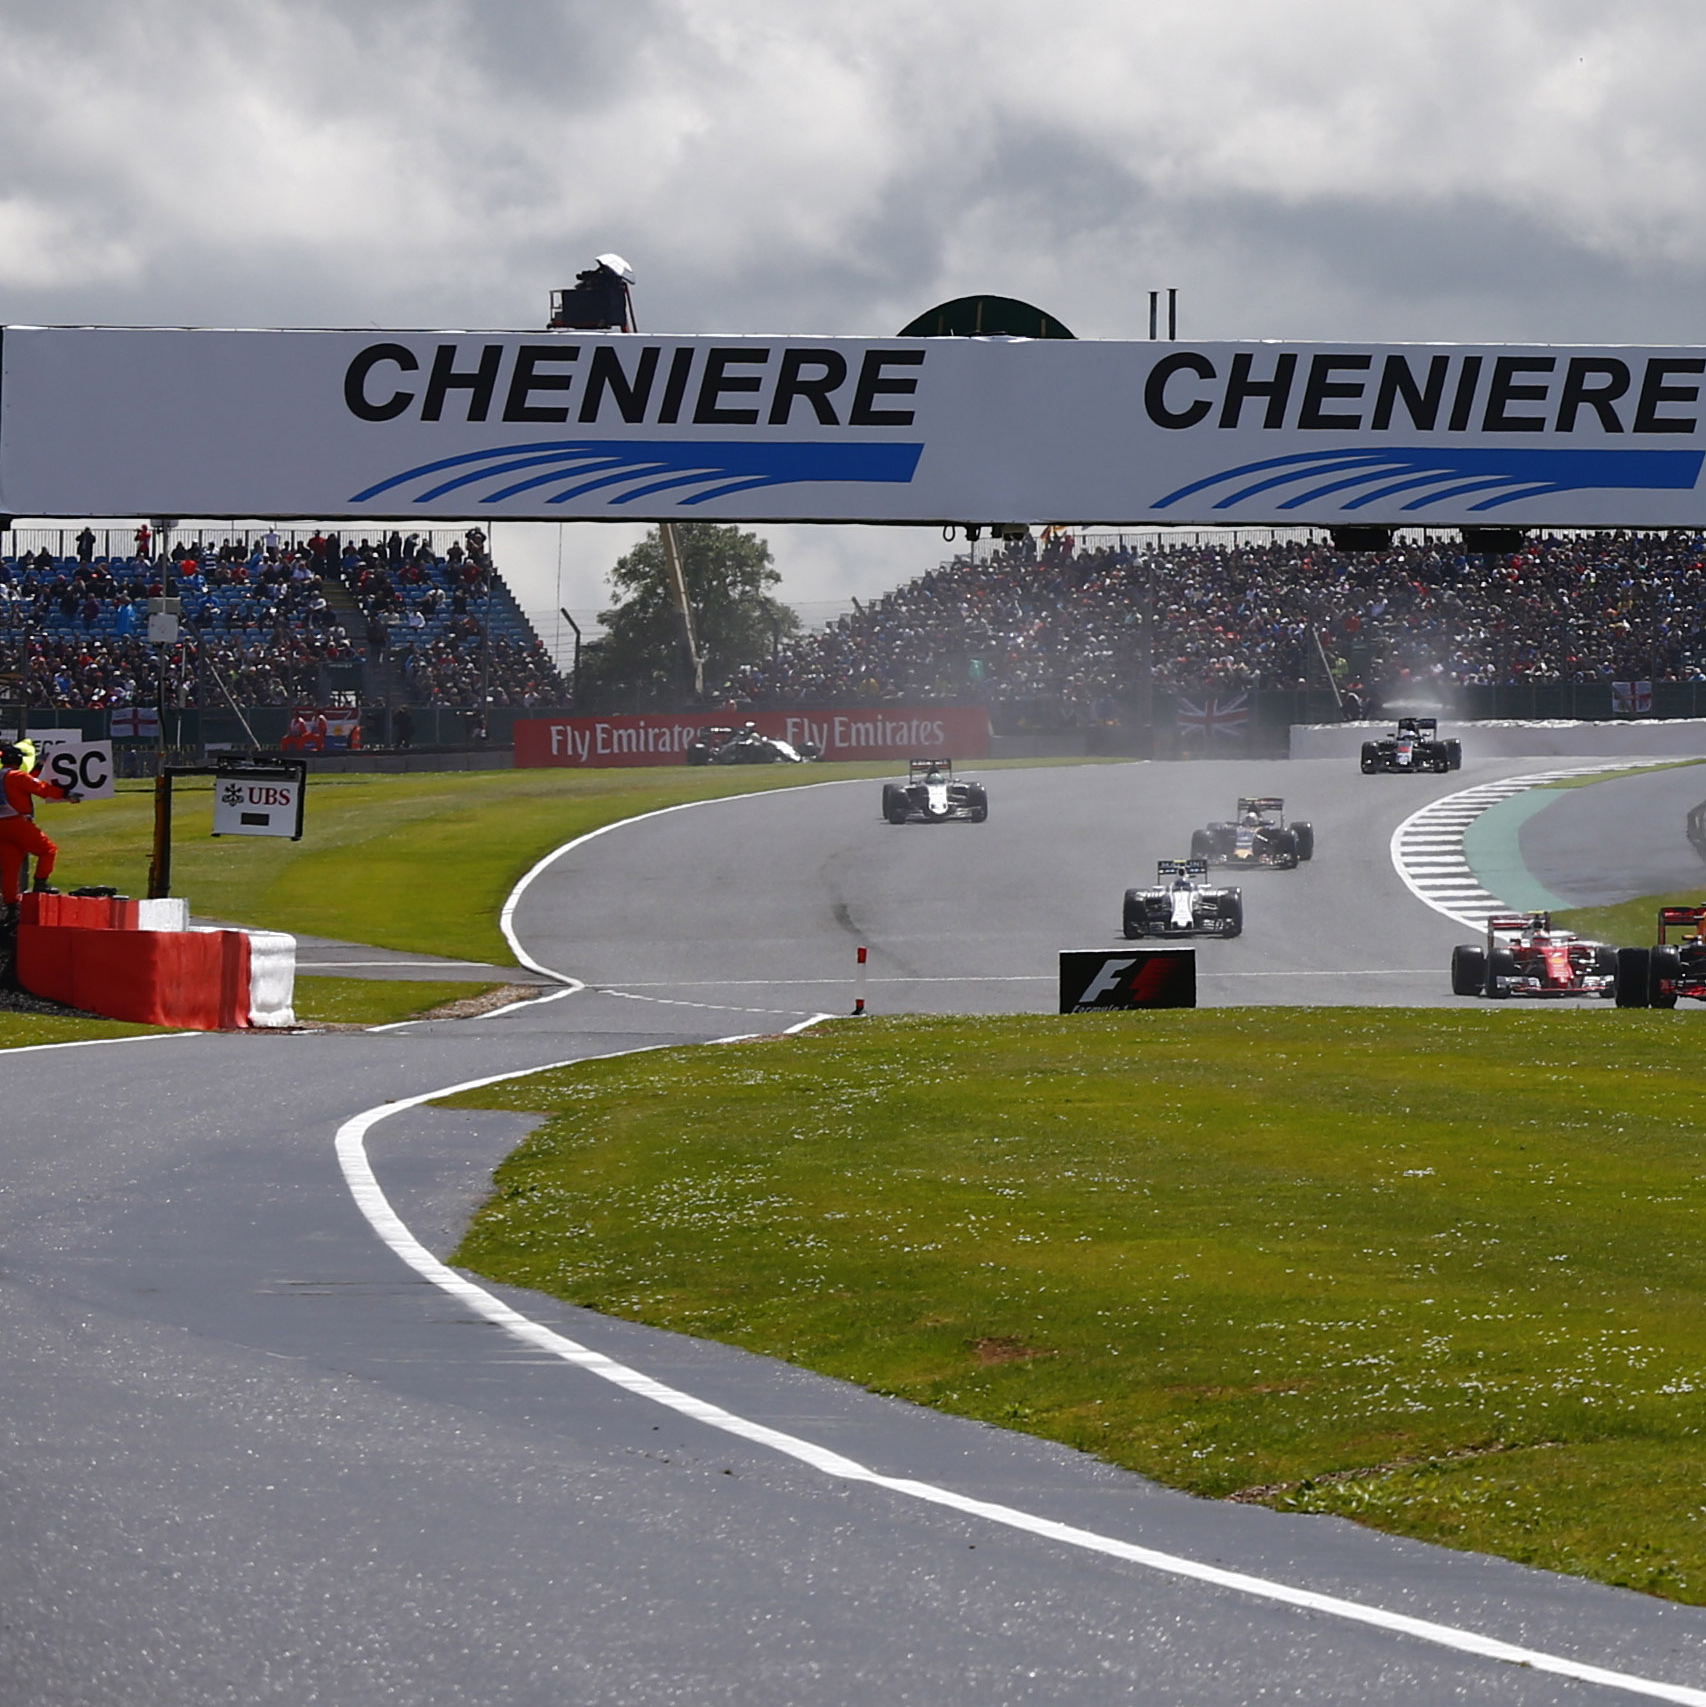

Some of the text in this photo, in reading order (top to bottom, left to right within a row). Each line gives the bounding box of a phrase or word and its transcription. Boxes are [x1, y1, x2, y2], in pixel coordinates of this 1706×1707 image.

[343, 342, 926, 426] CHENIERE
[1143, 351, 1706, 434] CHENIERE
[551, 725, 590, 762] Fly
[786, 714, 945, 756] Fly Emirates
[51, 750, 107, 791] SC
[248, 787, 291, 806] UBS
